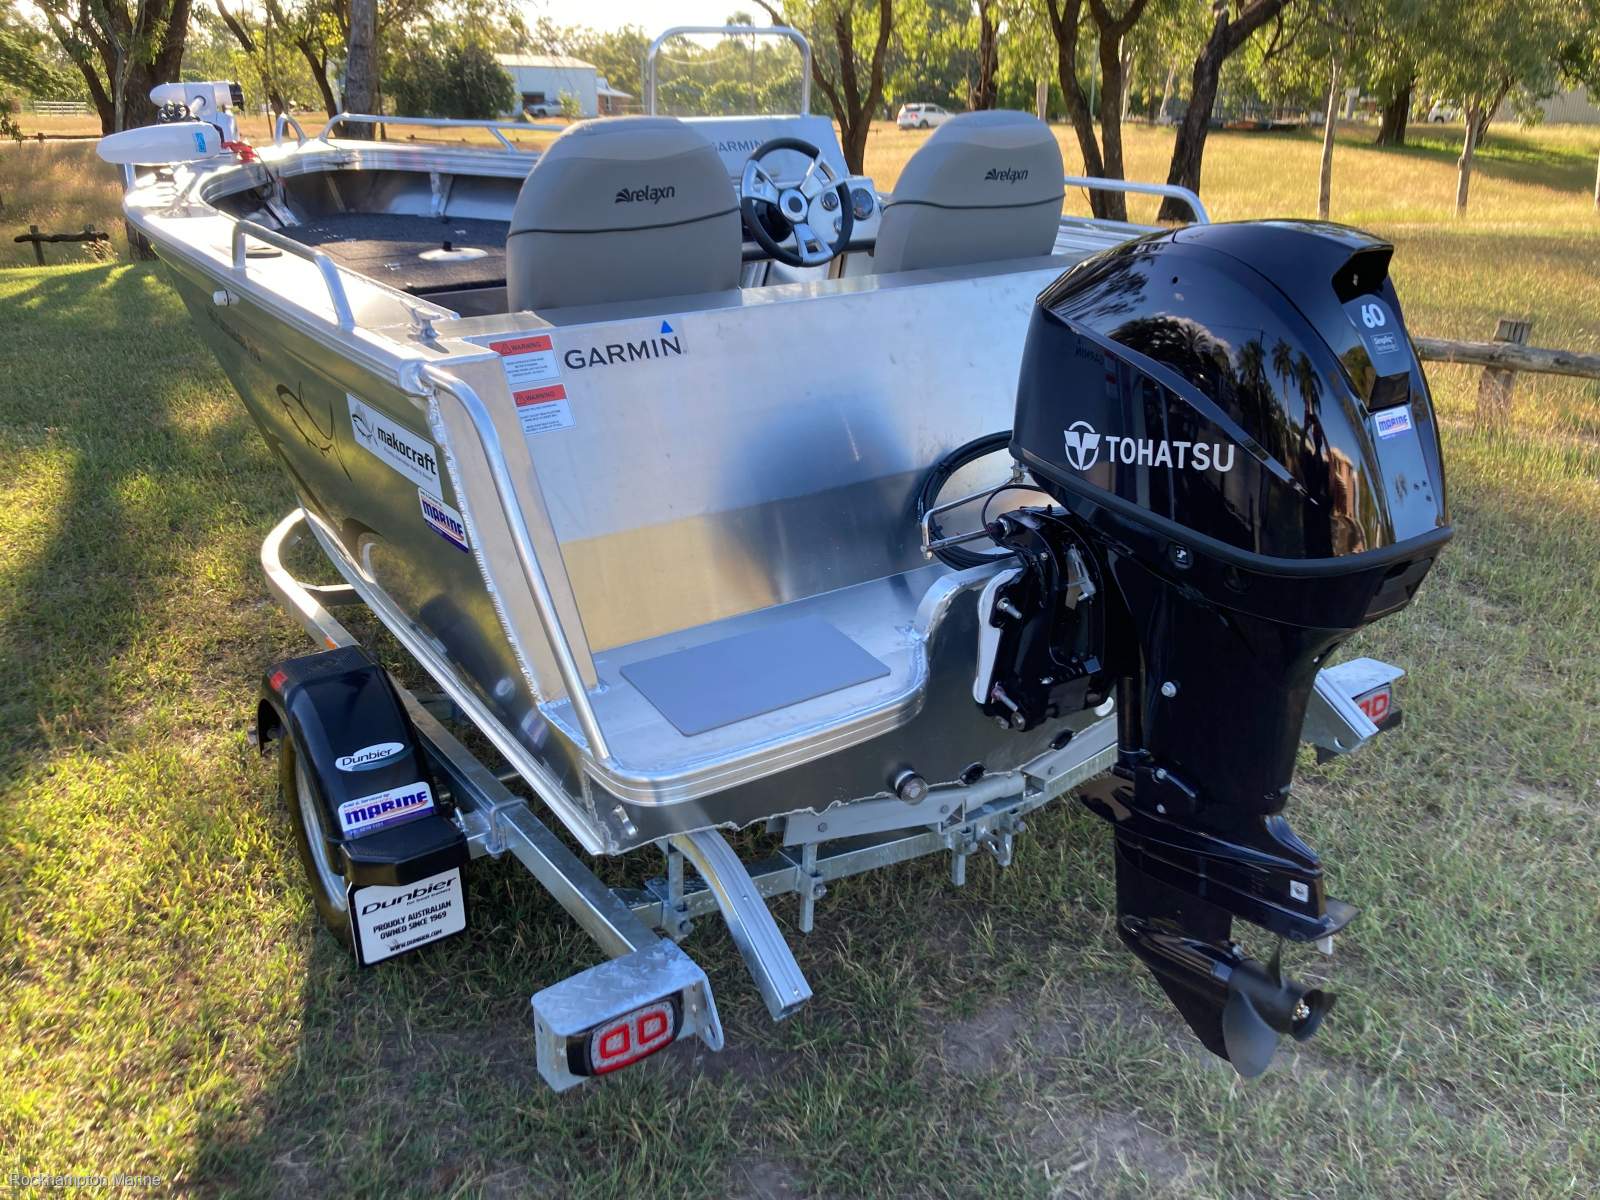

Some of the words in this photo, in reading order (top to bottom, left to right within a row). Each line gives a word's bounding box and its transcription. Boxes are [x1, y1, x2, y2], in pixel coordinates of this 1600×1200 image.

[630, 185, 675, 205] relaxn
[1361, 303, 1386, 329] 60
[564, 335, 682, 370] GARMIN
[377, 427, 437, 475] makocraft
[1105, 435, 1235, 472] TOHATSU
[422, 500, 464, 536] MARINE
[342, 748, 393, 766] Dunbier
[344, 791, 428, 825] MARINE
[362, 877, 457, 916] Dunbier
[373, 916, 406, 934] PROUDLY
[408, 900, 452, 922] AUSTRALIAN
[380, 925, 407, 940] OWNED
[409, 917, 428, 930] SINCE
[430, 911, 447, 922] 1969
